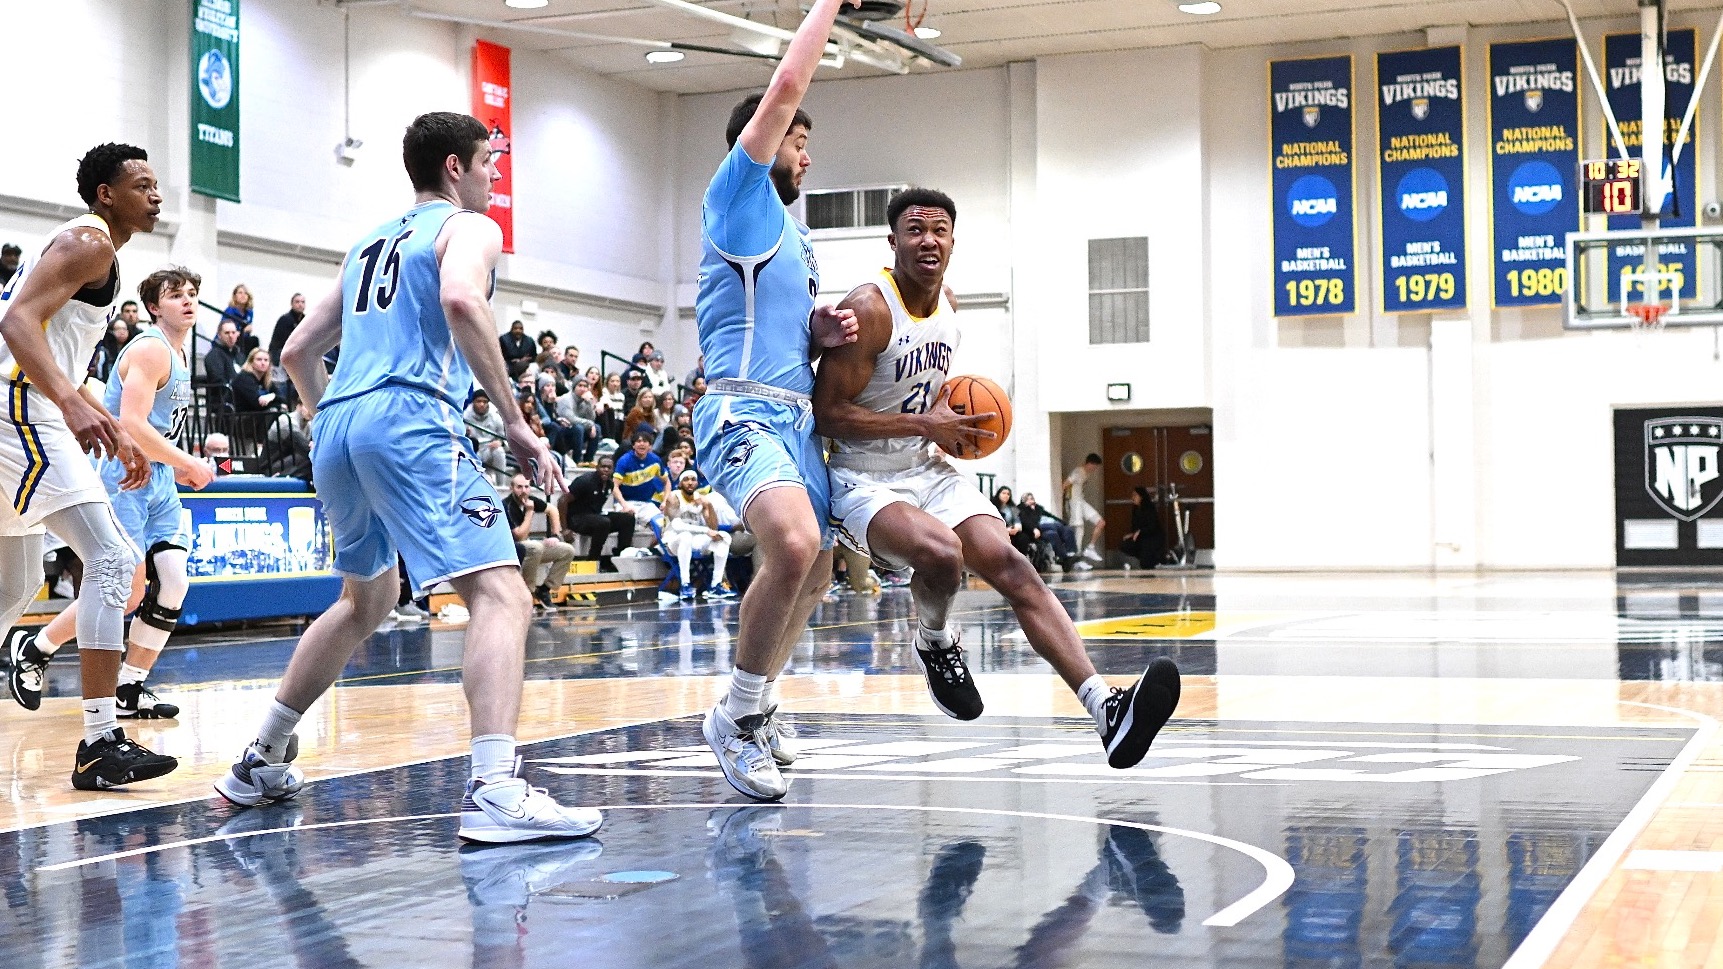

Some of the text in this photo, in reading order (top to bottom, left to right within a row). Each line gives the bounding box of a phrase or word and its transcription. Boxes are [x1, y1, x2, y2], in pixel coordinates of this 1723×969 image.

[1494, 71, 1574, 97] VIKINGS
[1610, 63, 1691, 89] VIKGS
[1274, 87, 1349, 113] VIKINGS
[1382, 78, 1459, 106] VIKINGS
[1391, 132, 1452, 148] NATIONAL
[1503, 125, 1566, 141] NATIONAL
[1282, 141, 1342, 155] NATIONAL
[1384, 144, 1459, 163] CHAMPIONS
[1496, 137, 1574, 155] CHAMPIONS
[1276, 152, 1348, 169] CHAMPIONS
[1589, 160, 1640, 181] 10:32
[1402, 191, 1448, 210] NCAA
[1513, 185, 1563, 203] NCAA
[1603, 181, 1632, 212] 10
[1292, 198, 1337, 215] NCAA
[1406, 241, 1440, 254] MEN'S
[1518, 235, 1554, 248] MEN'S
[1296, 247, 1331, 259] MEN'S
[1391, 252, 1457, 268] BASKETBALL
[1502, 247, 1566, 262] BASKETBAL
[354, 229, 415, 313] 15
[1281, 258, 1346, 272] BASKETBALL
[1395, 273, 1455, 302] 1979
[1507, 267, 1568, 297] 1980
[1286, 278, 1344, 306] 1978
[895, 341, 952, 382] VIKINGS
[901, 381, 931, 415] 21
[1655, 445, 1720, 511] NP
